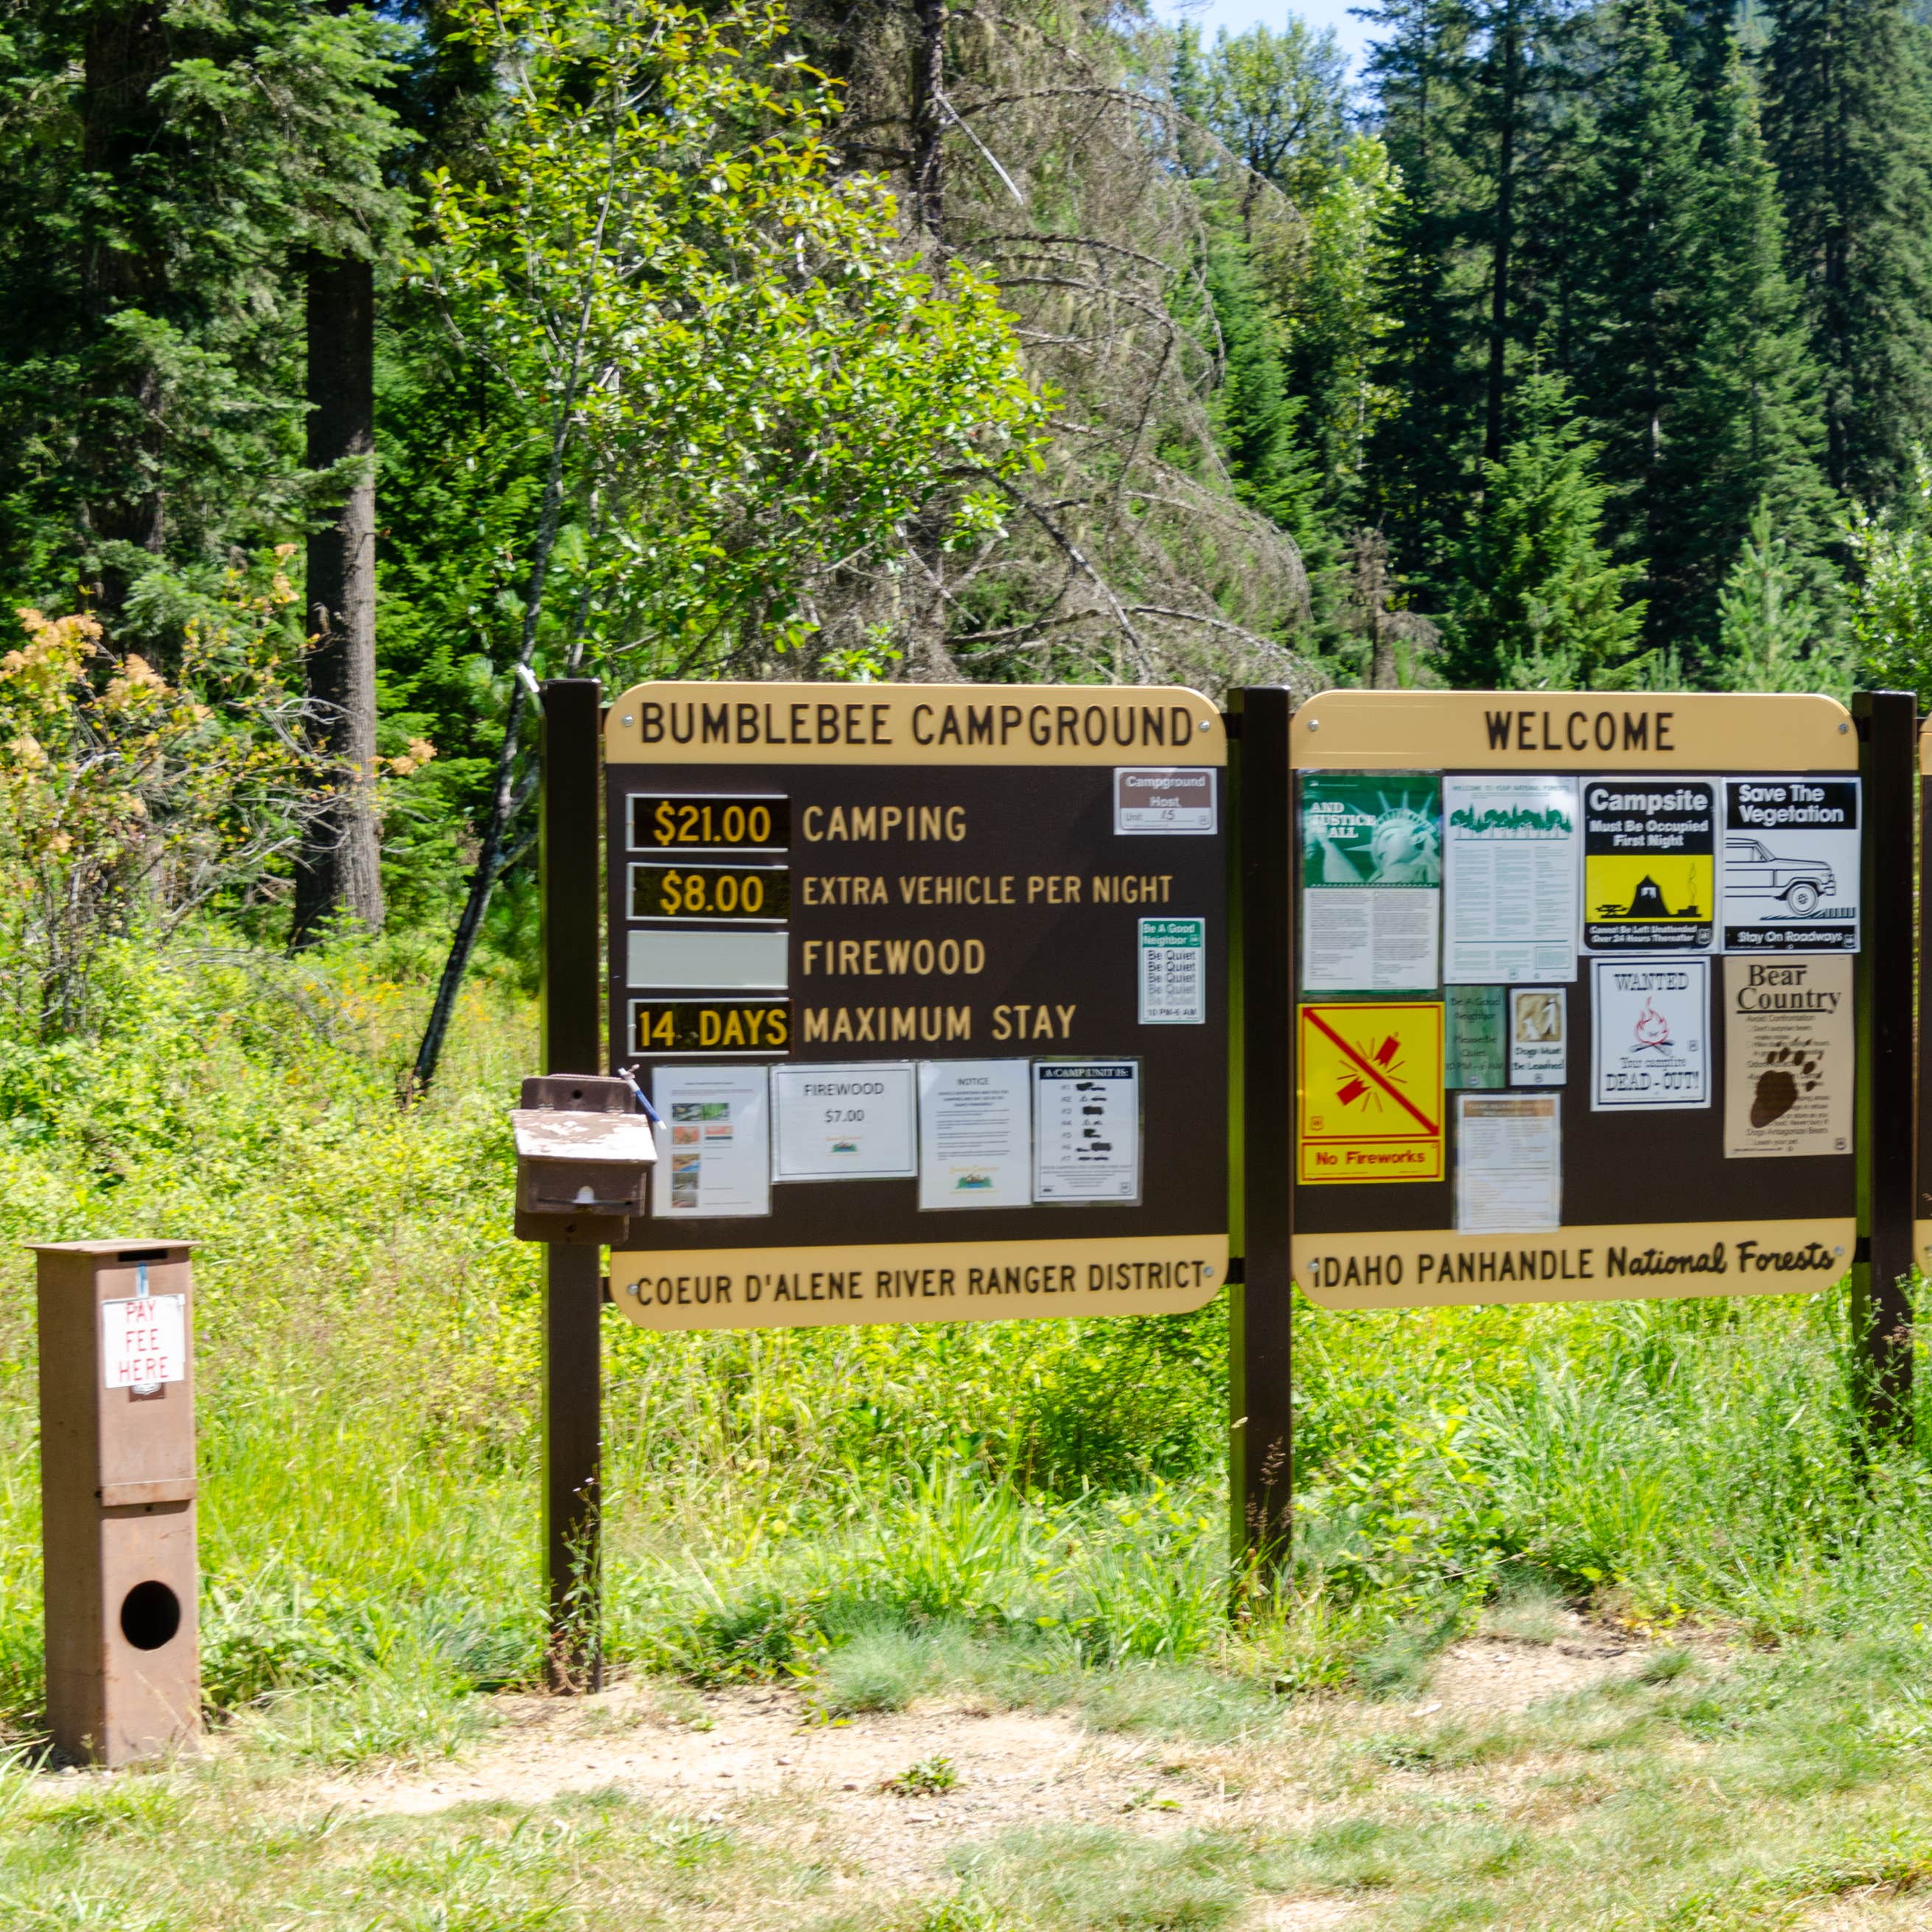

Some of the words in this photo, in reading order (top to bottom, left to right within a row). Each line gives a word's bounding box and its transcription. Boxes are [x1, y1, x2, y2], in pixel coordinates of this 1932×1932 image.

[641, 701, 892, 745] BUMBLEBEE
[912, 704, 1193, 746] CAMPGROUND
[1485, 711, 1675, 751] WELCOME
[1126, 776, 1205, 789] Campground
[1149, 796, 1180, 807] Host
[1589, 788, 1708, 815] Campsite
[1739, 784, 1786, 802] Save
[1789, 784, 1825, 802] The
[1310, 802, 1345, 813] AND
[1739, 805, 1844, 827] Vegetation
[654, 801, 771, 846] $21.00
[802, 805, 967, 841] CAMPING
[1311, 814, 1377, 825] JUSTICE
[1589, 820, 1622, 832] Must
[1624, 820, 1644, 832] Be
[1645, 819, 1709, 833] Occupied
[1327, 826, 1359, 839] ALL
[1613, 834, 1645, 846] First
[1647, 834, 1684, 849] Night
[660, 869, 763, 915] $8.00
[802, 876, 889, 905] EXTRA
[899, 875, 1015, 905] VEHICLE
[1027, 875, 1082, 904] PER
[1092, 875, 1172, 904] NIGHT
[1144, 924, 1156, 933] Be
[1158, 924, 1166, 933] A
[1167, 923, 1195, 933] Good
[1632, 925, 1650, 934] Left
[1651, 925, 1697, 933] Unattended
[1144, 936, 1188, 948] Neighbor
[1651, 934, 1695, 942] Thereafter
[1737, 931, 1763, 944] Stay
[1765, 931, 1783, 942] On
[1785, 931, 1842, 943] Roadways
[802, 939, 986, 976] FIREWOOD
[1149, 950, 1162, 960] Be
[1167, 950, 1196, 960] Quiet
[1149, 962, 1162, 972] Be
[1167, 962, 1196, 972] Quiet
[1748, 964, 1807, 986] Bear
[1149, 973, 1162, 983] Be
[1167, 973, 1196, 983] Quiet
[1614, 973, 1690, 991] WANTED
[1737, 987, 1841, 1014] Country
[639, 1011, 676, 1046] 14
[699, 1009, 788, 1046] DAYS
[802, 1006, 971, 1043] MAXIMUM
[992, 1004, 1077, 1040] STAY
[1620, 1057, 1643, 1068] Your
[1644, 1056, 1687, 1069] campfire
[956, 1077, 990, 1085] NOTICE
[1043, 1069, 1053, 1077] A
[1054, 1069, 1085, 1077] CAMP
[1085, 1068, 1114, 1077] UNIT
[803, 1082, 884, 1096] FIREWOOD
[825, 1108, 865, 1123] $7.00
[1315, 1152, 1338, 1166] No
[1346, 1149, 1426, 1165] Fireworks
[1313, 1254, 1403, 1287] IDAHO
[1418, 1248, 1594, 1284] PANHANDLE
[1607, 1241, 1726, 1278] National
[1736, 1239, 1835, 1273] Forests
[637, 1275, 732, 1306] COEUR
[746, 1271, 863, 1302] D'ALENE
[876, 1268, 955, 1298] RIVER
[968, 1264, 1076, 1295] RANGER
[1089, 1260, 1205, 1292] DISTRICT
[125, 1300, 157, 1323] PAY
[125, 1329, 160, 1351] FEE
[118, 1357, 169, 1383] HERE
